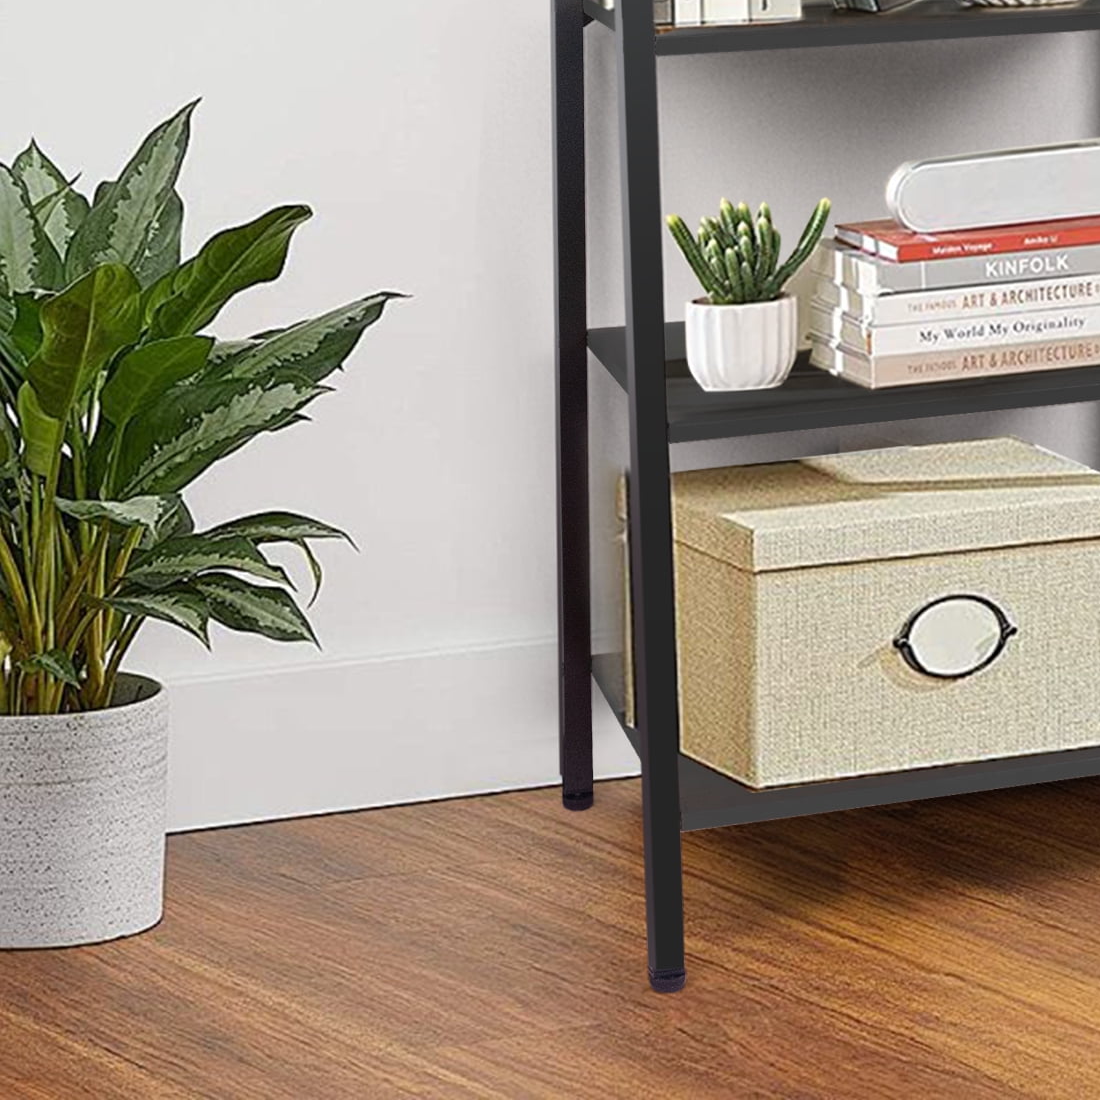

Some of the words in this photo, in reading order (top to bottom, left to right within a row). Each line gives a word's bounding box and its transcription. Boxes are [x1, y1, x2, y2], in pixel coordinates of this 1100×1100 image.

[985, 254, 1069, 278] KINFOLK
[961, 293, 985, 310] ART
[989, 291, 998, 307] &
[1000, 281, 1093, 306] ARCHITECTURE
[919, 330, 939, 343] My
[943, 325, 985, 339] World
[988, 322, 1009, 336] My
[1012, 315, 1086, 334] Originality
[961, 354, 985, 371] ART
[988, 352, 998, 368] &
[1000, 342, 1093, 366] ARCHITECTURE
